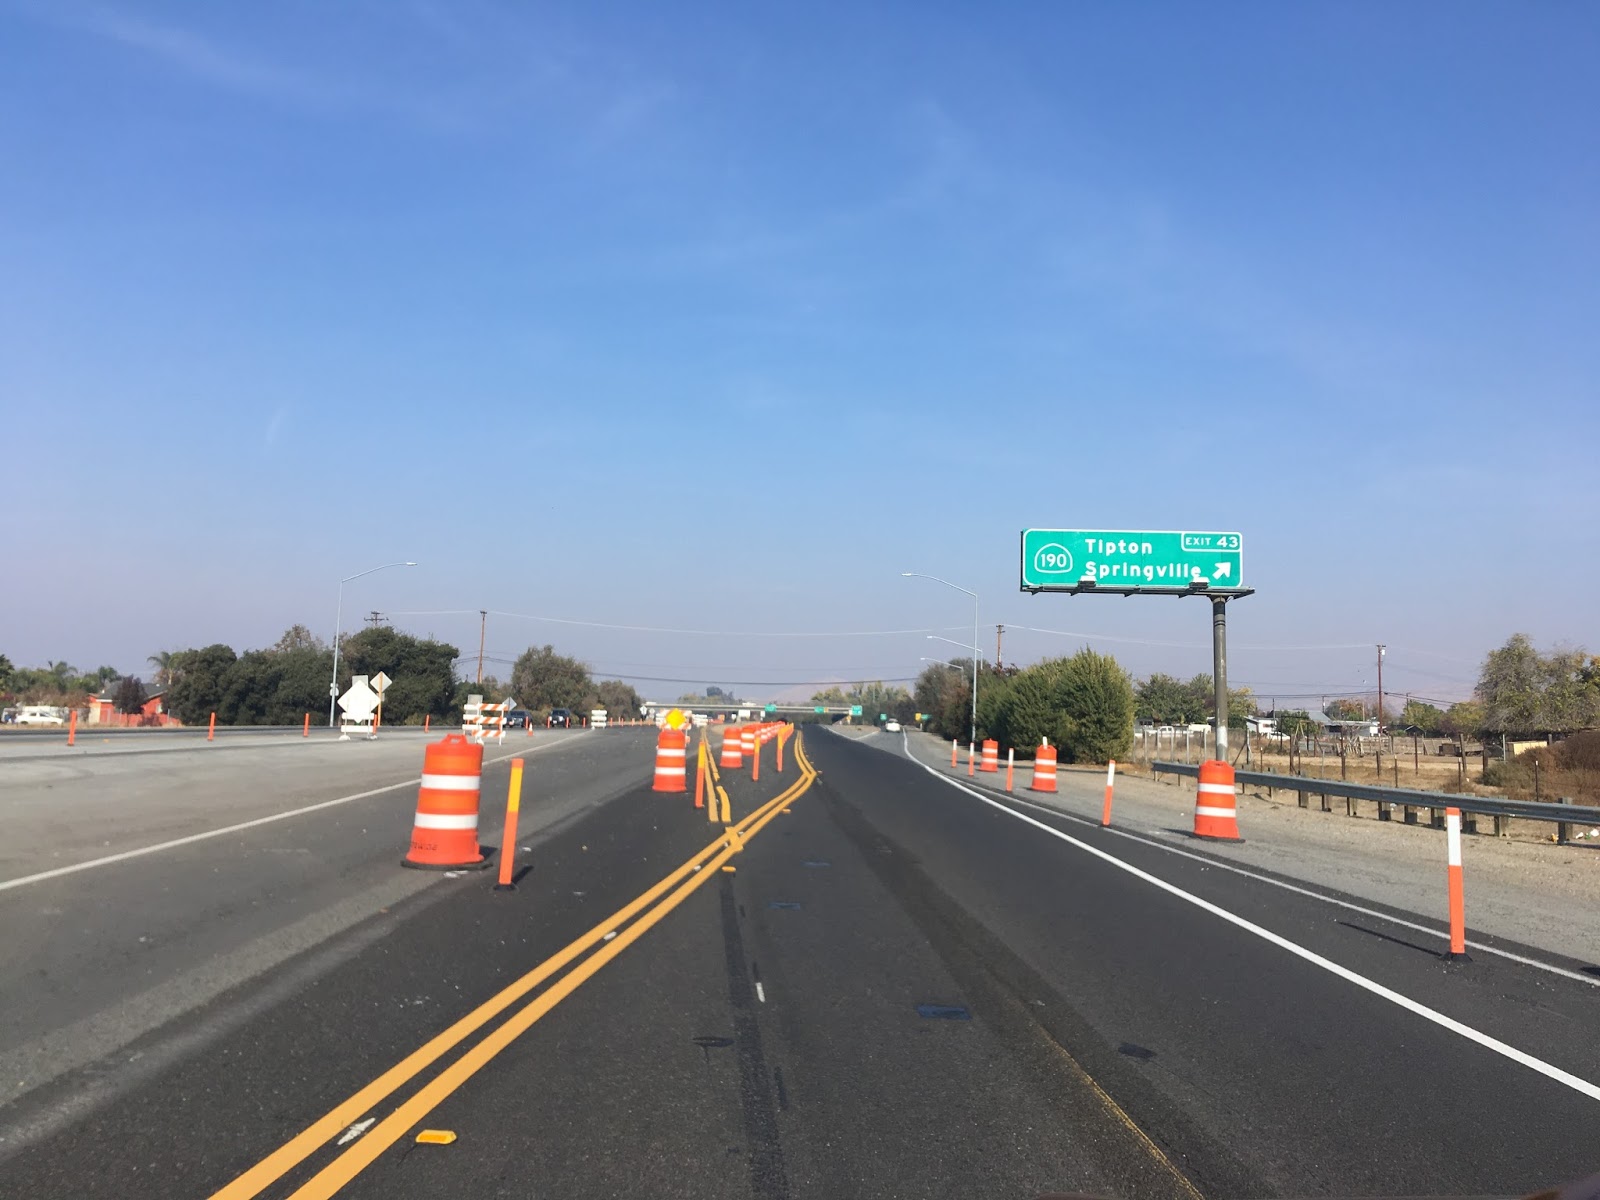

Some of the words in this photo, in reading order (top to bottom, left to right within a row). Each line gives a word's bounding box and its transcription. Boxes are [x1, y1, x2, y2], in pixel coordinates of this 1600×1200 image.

[1085, 538, 1152, 555] Tipton
[1185, 536, 1211, 546] EXIT
[1216, 536, 1239, 548] 43
[1040, 553, 1067, 568] 190
[1085, 561, 1201, 580] Springville
